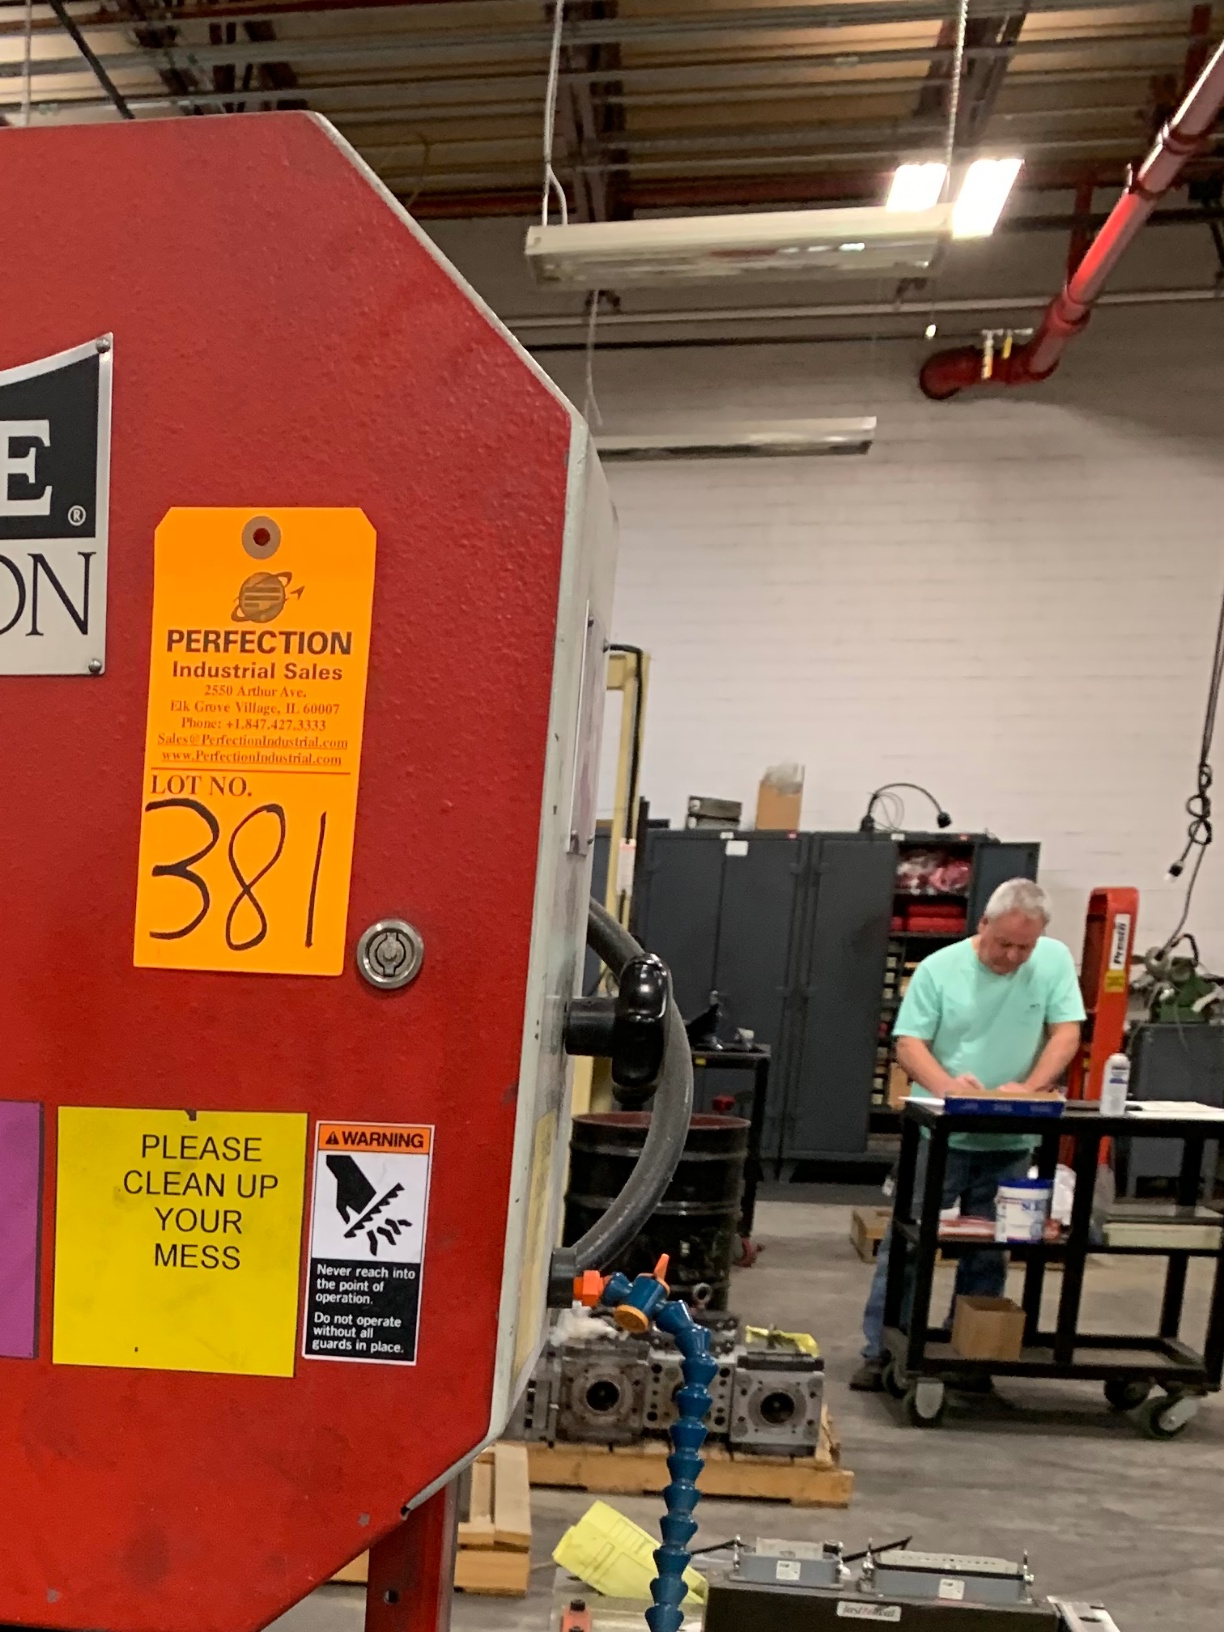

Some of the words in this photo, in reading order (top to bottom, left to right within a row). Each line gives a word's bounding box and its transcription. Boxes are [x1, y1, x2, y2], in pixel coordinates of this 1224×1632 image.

[166, 629, 353, 655] PERFECTION
[172, 660, 276, 679] Industrial
[283, 662, 343, 680] Sales
[204, 684, 233, 696] 2550
[237, 685, 278, 697] Arthur
[280, 686, 307, 698] Ave.
[170, 700, 190, 712] Elk
[194, 701, 231, 713] Grove
[235, 701, 281, 716] Village,
[285, 702, 299, 714] IL
[303, 703, 340, 715] 60007
[181, 717, 222, 729] Phone:
[157, 732, 349, 750] Sales@PerfectionIndustrial.com
[161, 750, 342, 766] www.PerfectionIndustrial.com
[150, 774, 202, 794] LOT
[209, 776, 253, 797] NO.
[145, 797, 328, 951] 381
[341, 1130, 425, 1148] WARNING
[141, 1134, 263, 1164] PLEASE
[123, 1170, 227, 1199] CLEAN
[237, 1174, 279, 1200] UP
[154, 1207, 244, 1236] YOUR
[153, 1243, 242, 1271] MESS
[316, 1264, 352, 1277] Never
[355, 1266, 389, 1279] reach
[393, 1266, 416, 1280] into
[316, 1277, 336, 1290] the
[339, 1279, 369, 1293] point
[372, 1280, 384, 1292] of
[315, 1291, 373, 1305] operation.
[314, 1311, 331, 1324] Do
[334, 1313, 353, 1325] not
[356, 1315, 402, 1329] operate
[313, 1326, 357, 1338] without
[360, 1326, 374, 1339] all
[312, 1339, 353, 1352] guards
[355, 1340, 367, 1351] in
[370, 1341, 404, 1354] place.
